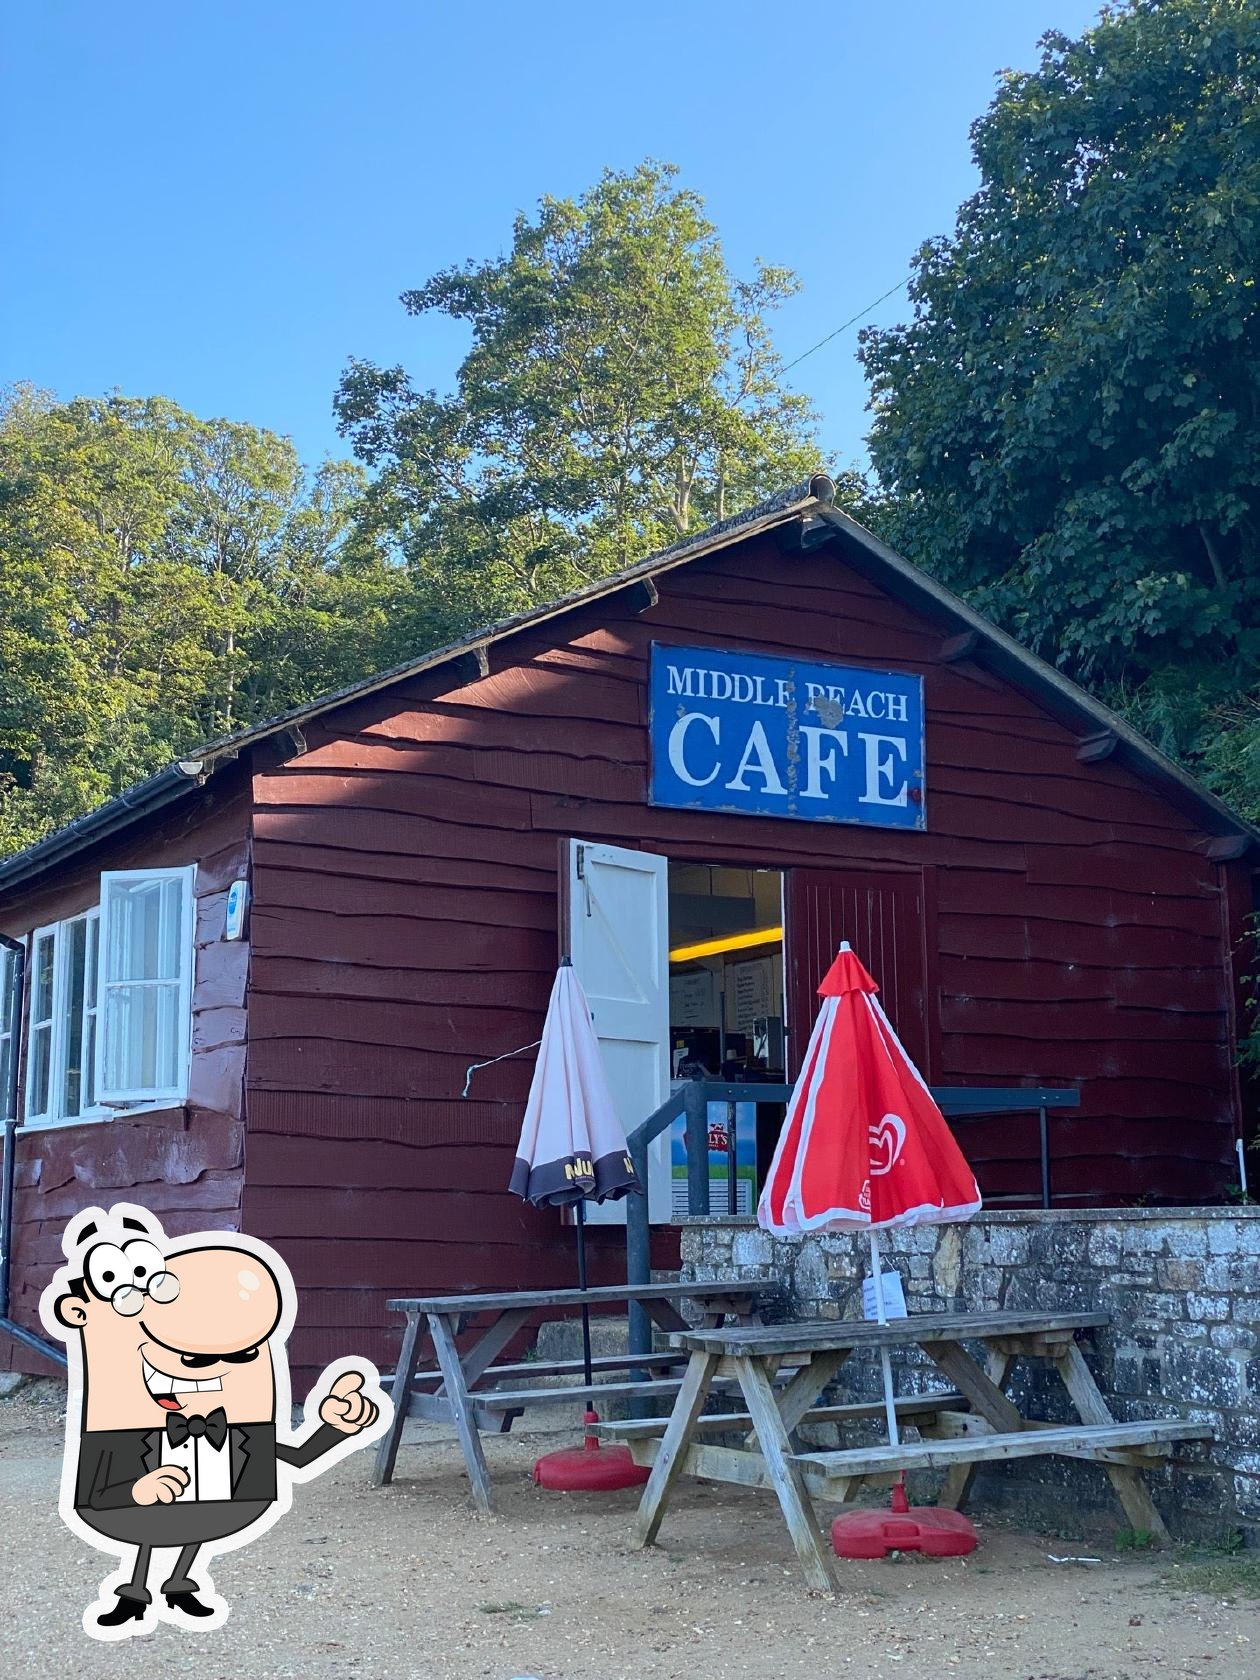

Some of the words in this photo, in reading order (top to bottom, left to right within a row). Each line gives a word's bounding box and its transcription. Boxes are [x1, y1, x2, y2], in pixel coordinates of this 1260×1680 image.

[667, 665, 796, 708] MIDDLE
[804, 682, 909, 722] BEACH
[668, 712, 908, 808] CAFE
[709, 1133, 728, 1146] LY'S
